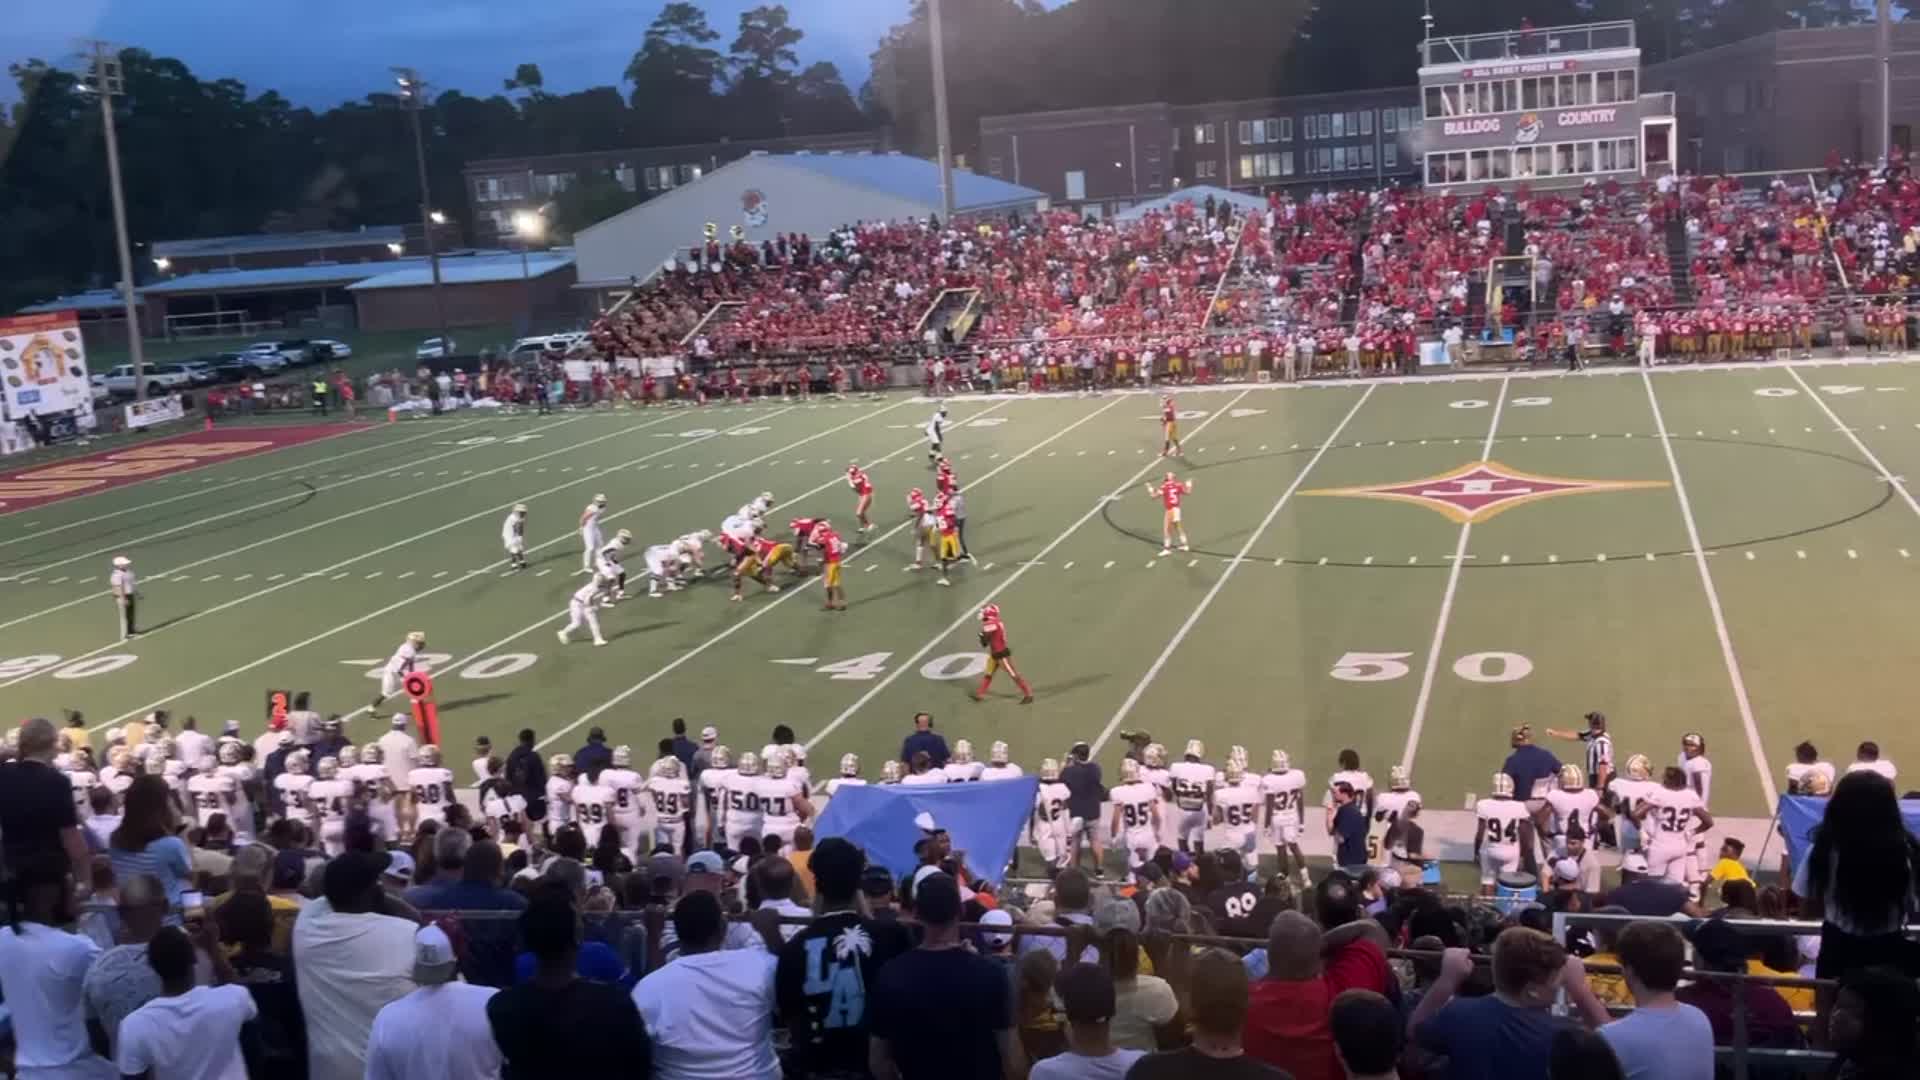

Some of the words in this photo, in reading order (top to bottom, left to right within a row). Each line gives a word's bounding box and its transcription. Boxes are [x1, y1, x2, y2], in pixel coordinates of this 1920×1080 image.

[1444, 118, 1501, 136] BULLDOG
[1558, 109, 1616, 126] COUNTRY
[815, 652, 988, 680] 40
[1329, 651, 1533, 683] 50
[655, 790, 679, 815] 89
[730, 789, 759, 813] 50
[759, 796, 787, 817] 77
[1124, 801, 1149, 828] 95
[1227, 804, 1253, 827] 65
[1659, 805, 1690, 833] 32
[1487, 817, 1517, 843] 94
